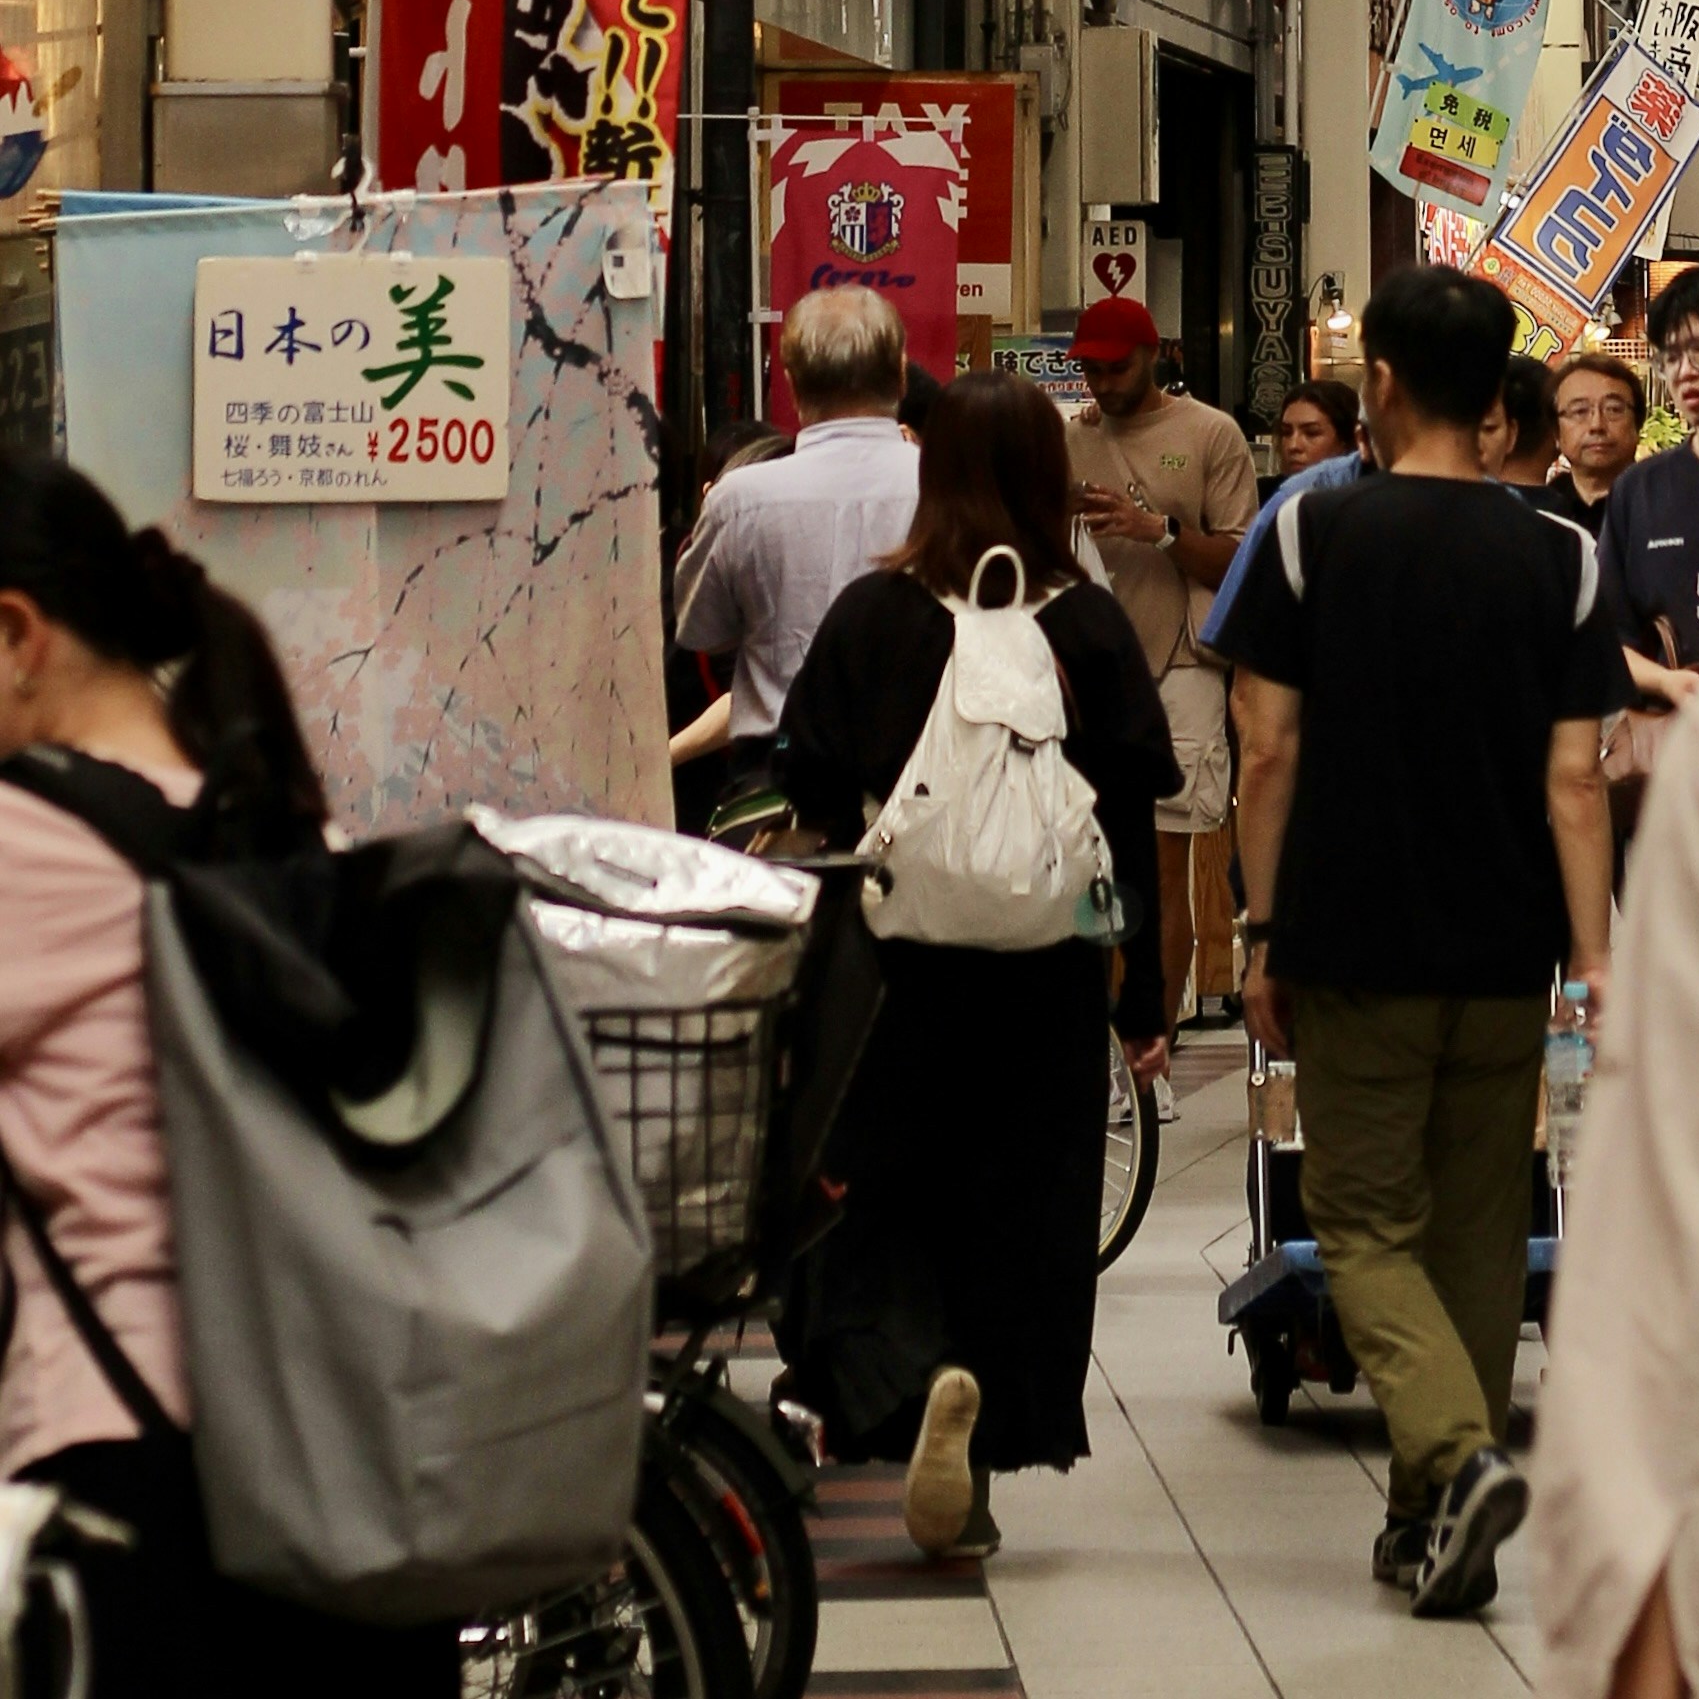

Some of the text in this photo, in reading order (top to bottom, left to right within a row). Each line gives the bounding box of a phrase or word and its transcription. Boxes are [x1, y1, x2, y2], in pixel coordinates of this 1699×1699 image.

[1439, 92, 1493, 133] 免税
[1429, 126, 1477, 159] 면세
[1092, 225, 1138, 248] AED
[1251, 152, 1295, 365] EBISUYA
[206, 274, 486, 411] 日本の美
[225, 400, 375, 427] 四季の富士山
[223, 417, 496, 467] 桜・舞妓さん ¥2500
[219, 466, 388, 490] 七福ろう・京都のれん
